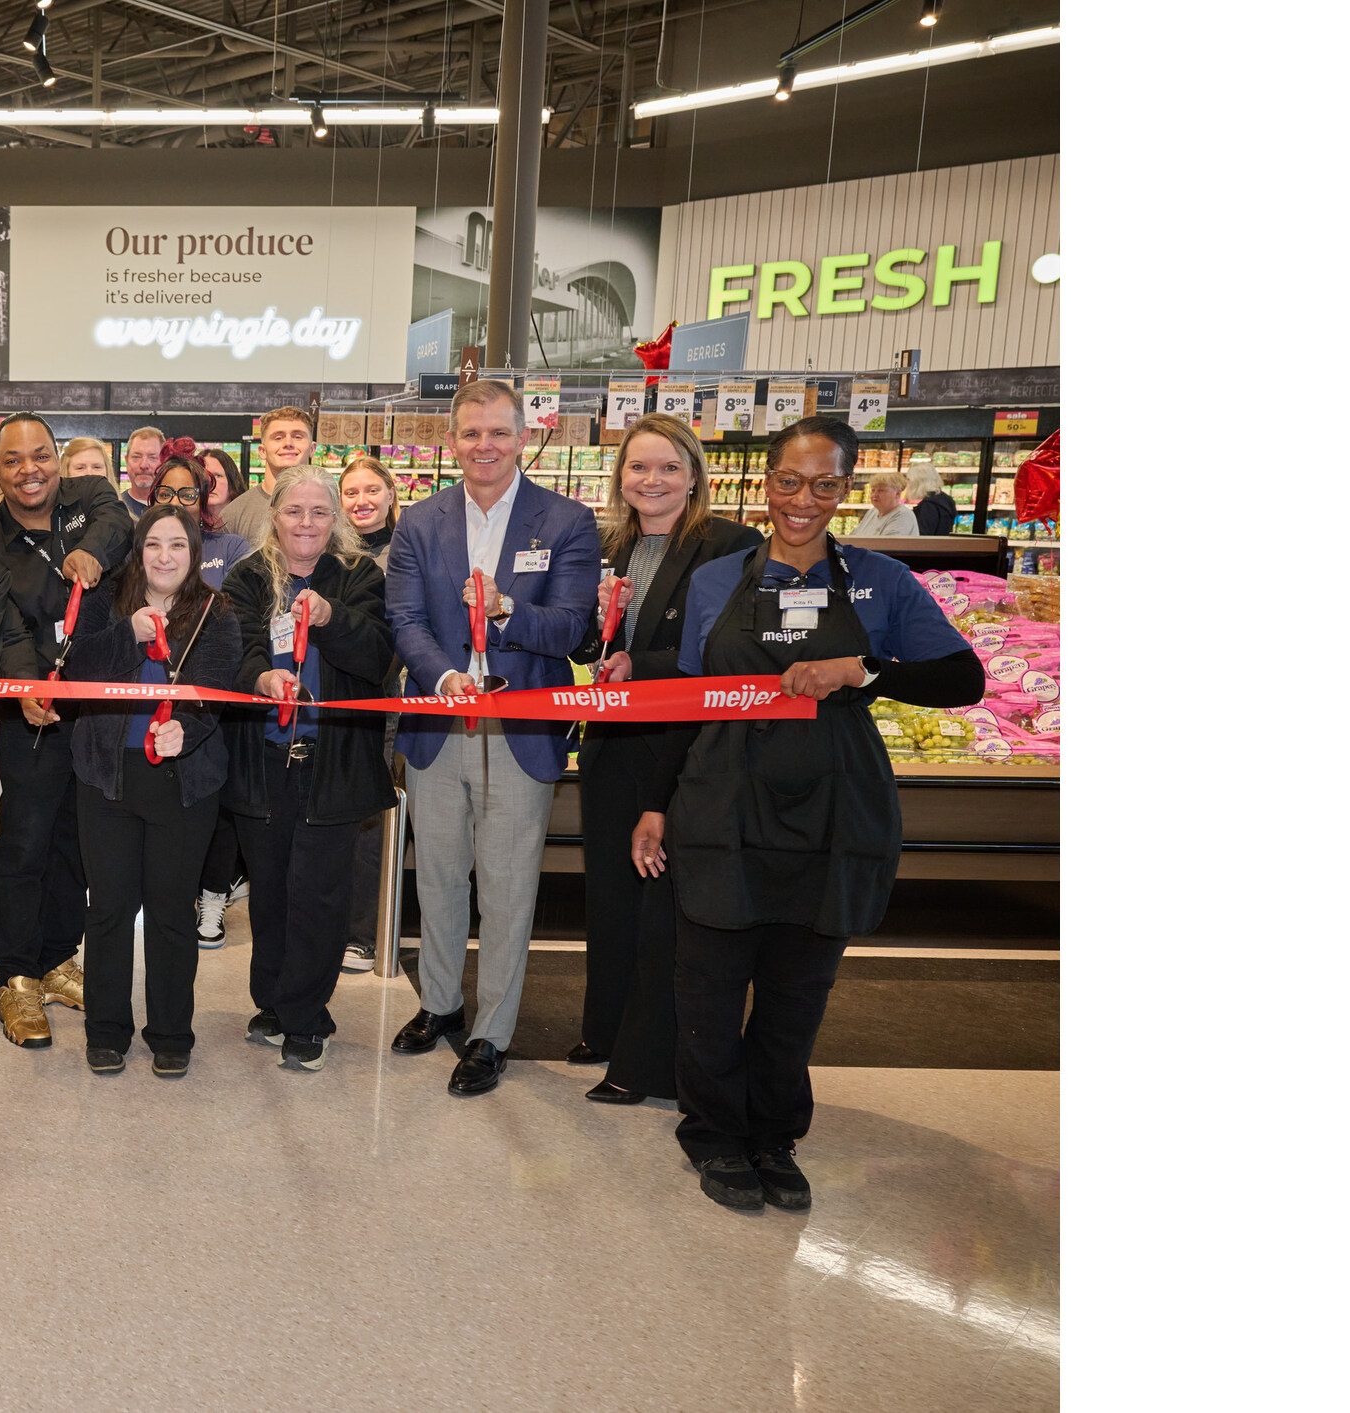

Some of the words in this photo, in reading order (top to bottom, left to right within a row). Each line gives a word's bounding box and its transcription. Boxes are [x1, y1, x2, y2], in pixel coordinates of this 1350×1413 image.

[106, 226, 168, 256] Our
[176, 226, 314, 264] produce
[106, 269, 119, 283] is
[123, 268, 185, 283] fresher
[190, 268, 262, 283] because
[707, 240, 1002, 320] FRESH
[133, 289, 212, 304] delivered
[96, 317, 192, 359] every
[187, 306, 293, 359] single
[292, 306, 362, 360] day
[416, 340, 438, 360] GRAPES
[687, 342, 726, 362] BERRIES
[464, 359, 474, 369] A
[912, 362, 919, 371] A
[465, 372, 472, 382] 7
[912, 375, 917, 385] 7
[182, 396, 205, 407] YEARS
[762, 629, 808, 644] meijer
[993, 662, 1026, 676] Grapery
[105, 686, 180, 697] meijer
[1027, 683, 1057, 693] Grapery
[552, 687, 630, 712] meijer
[703, 684, 781, 711] meijer
